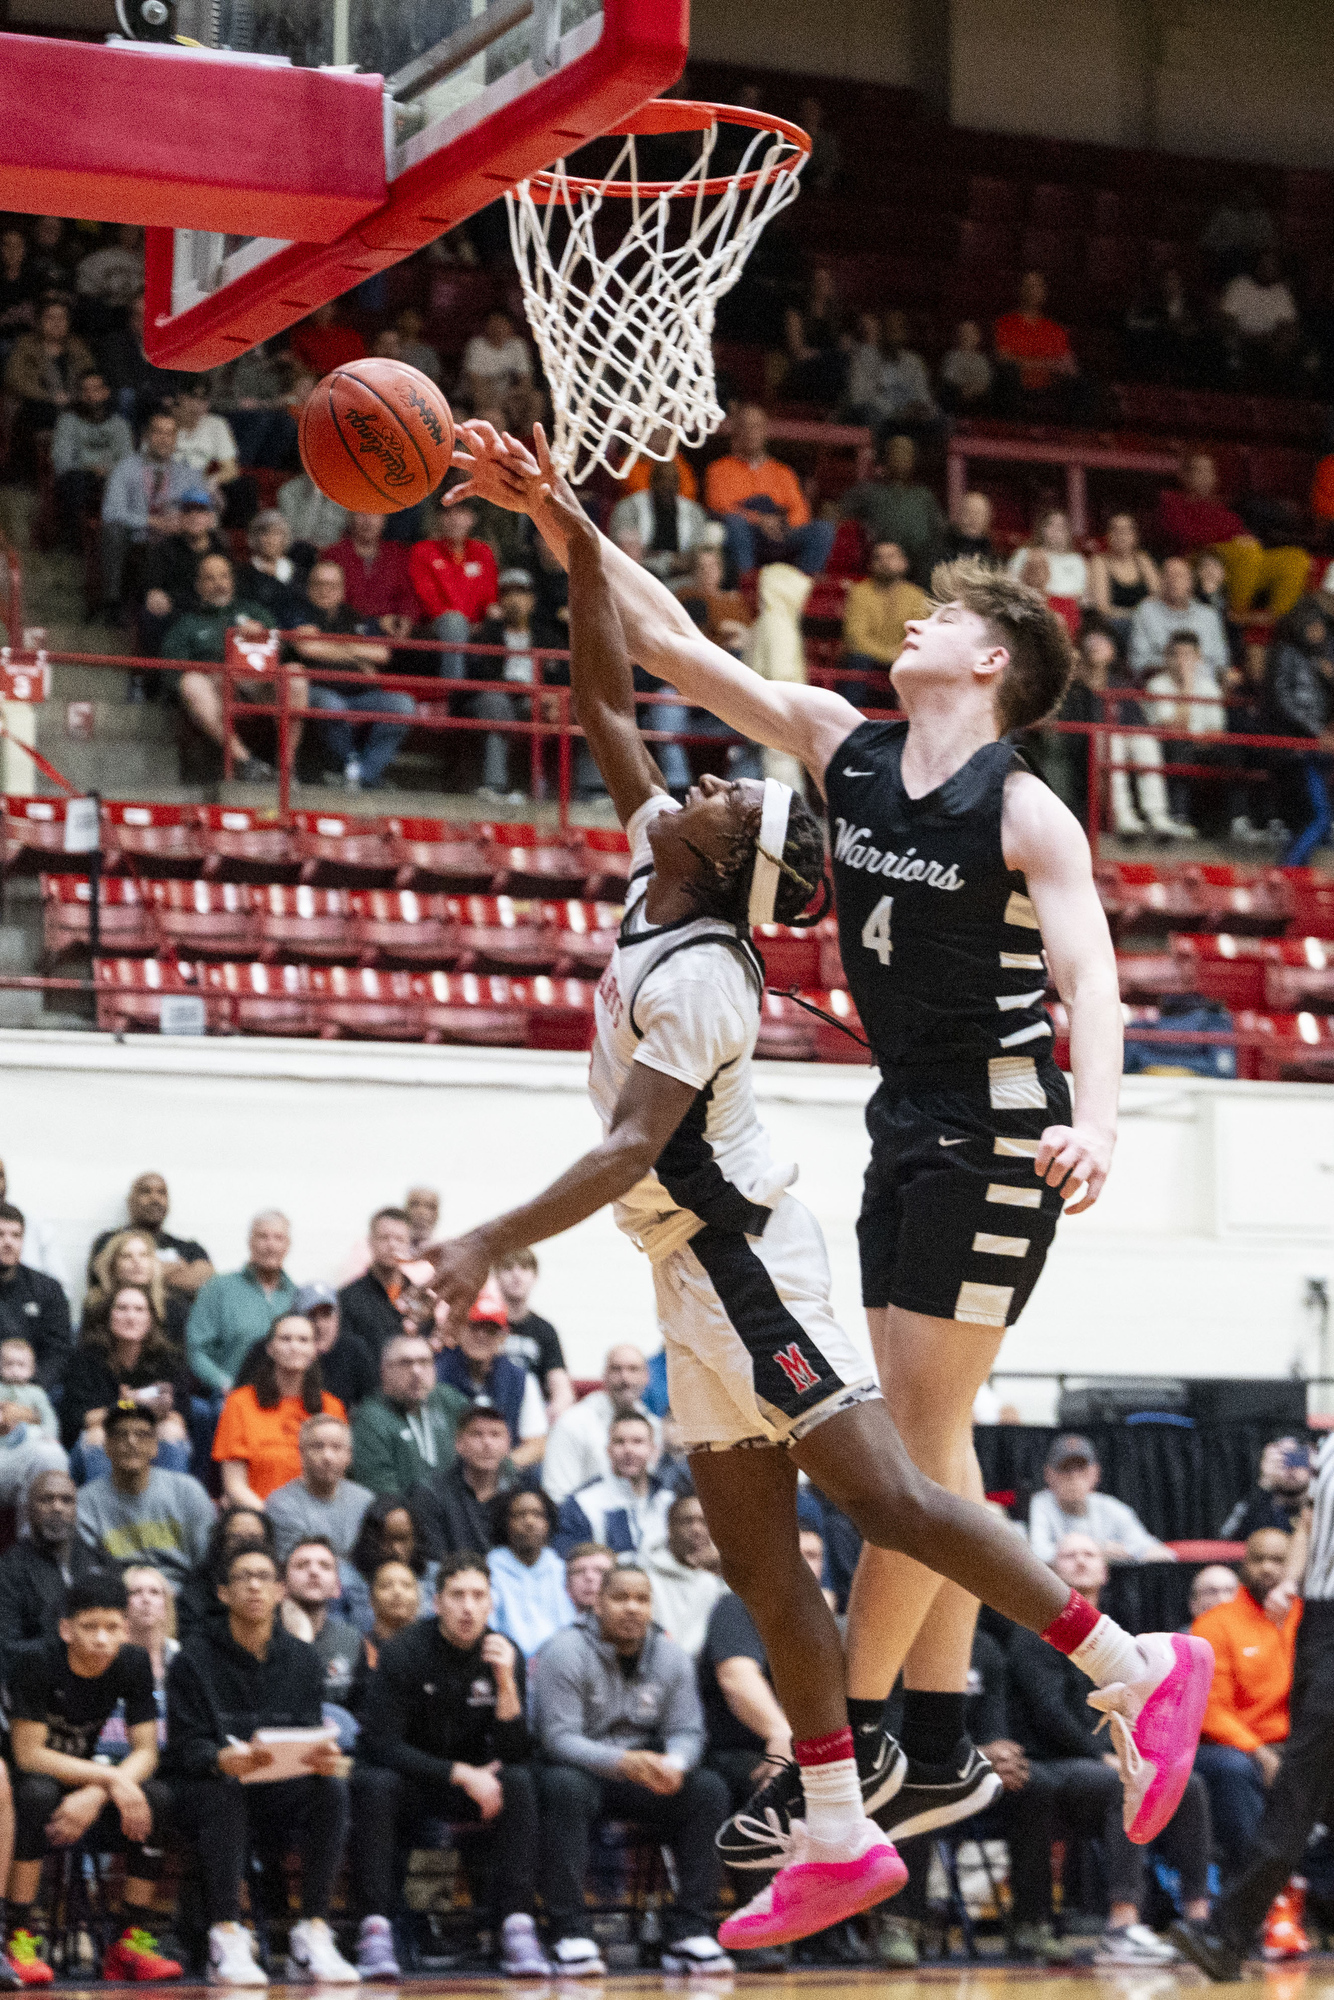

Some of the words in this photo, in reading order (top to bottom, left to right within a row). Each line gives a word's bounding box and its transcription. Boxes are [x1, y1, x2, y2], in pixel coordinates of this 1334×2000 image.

[344, 408, 415, 487] Rawlings
[834, 817, 965, 891] Warriors
[861, 894, 895, 966] 4
[772, 1342, 823, 1395] M
